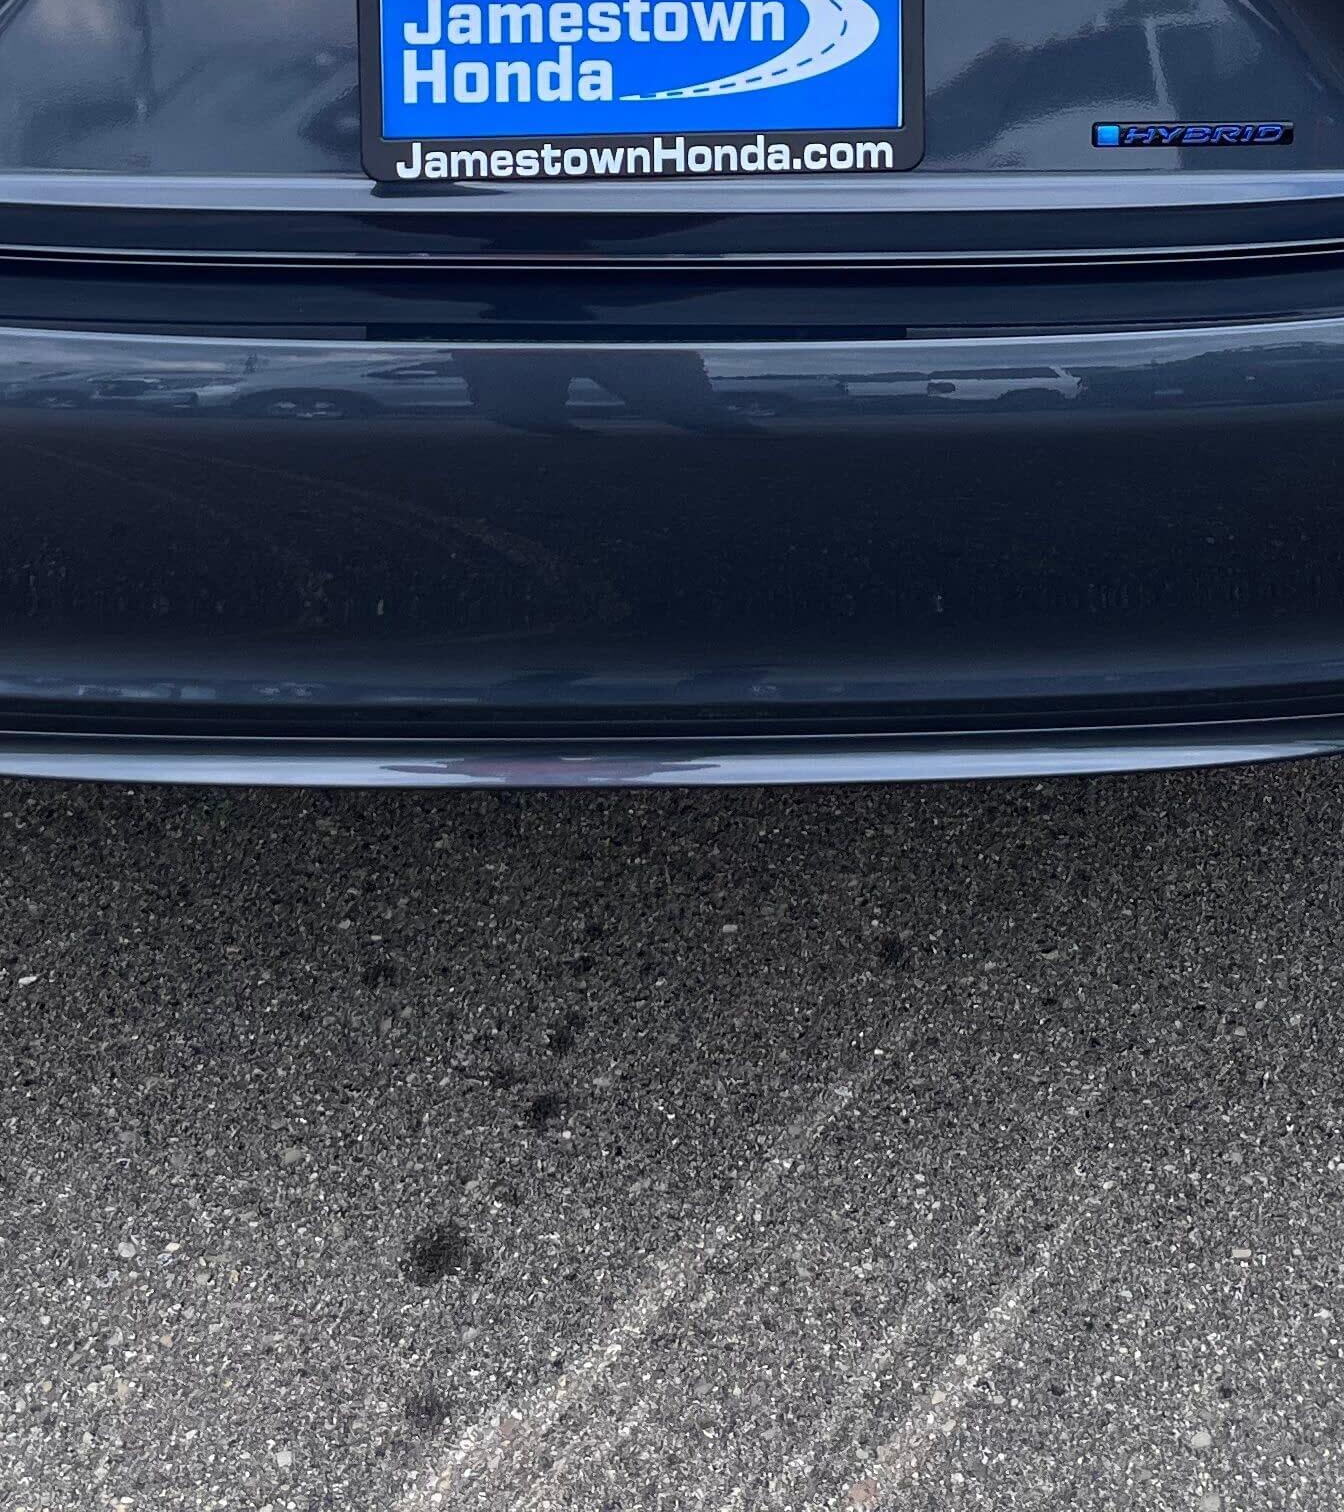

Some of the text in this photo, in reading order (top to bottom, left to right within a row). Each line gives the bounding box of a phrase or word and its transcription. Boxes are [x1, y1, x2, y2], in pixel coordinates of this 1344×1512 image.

[403, 45, 613, 104] Honda
[395, 134, 894, 180] JamestownHonda.com
[1123, 124, 1283, 144] HYBRID
